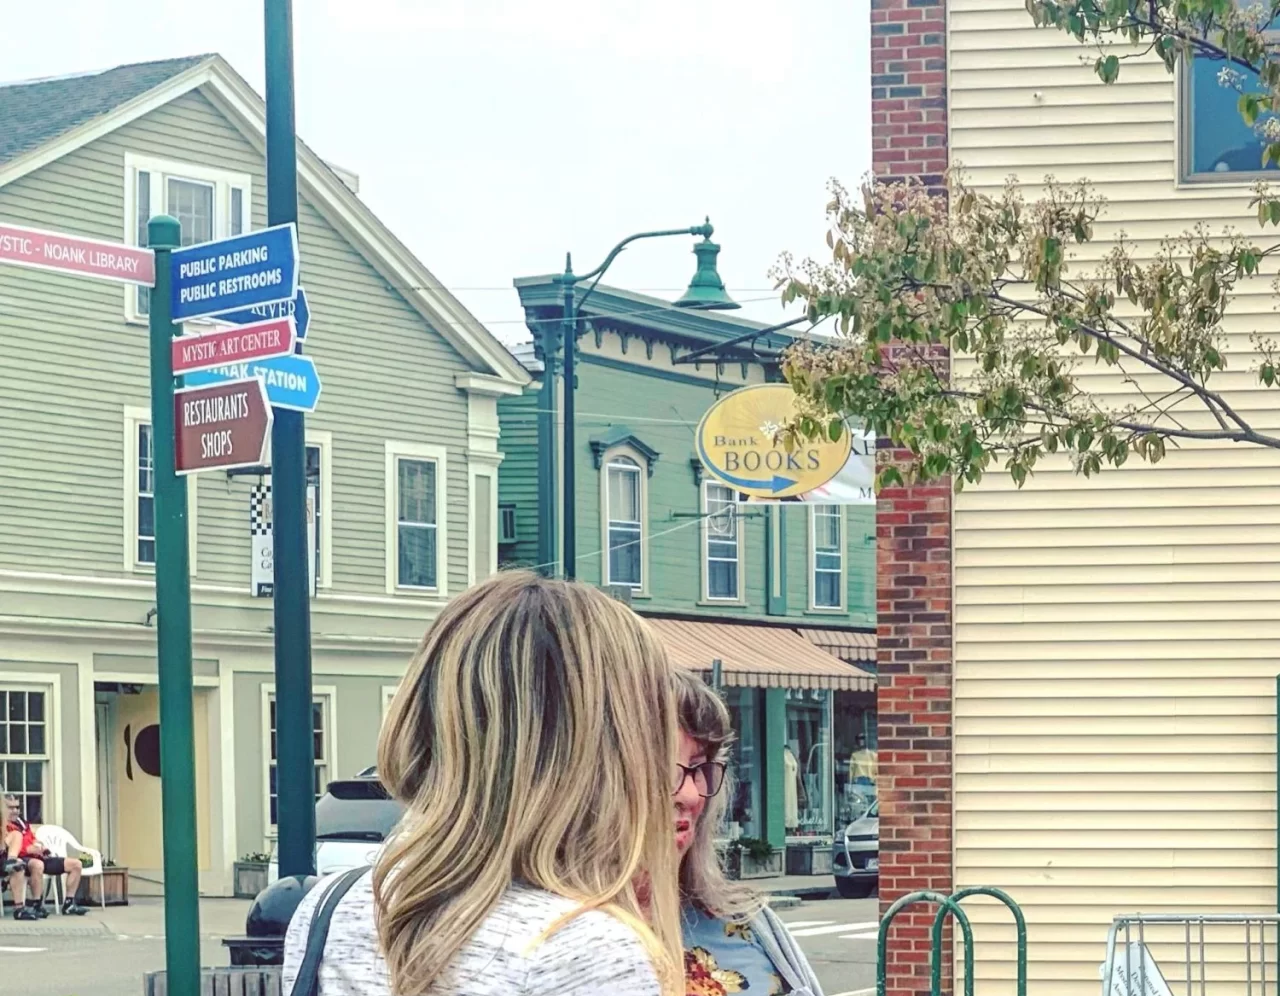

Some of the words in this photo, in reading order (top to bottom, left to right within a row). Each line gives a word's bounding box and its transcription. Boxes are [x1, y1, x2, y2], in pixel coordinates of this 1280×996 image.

[44, 242, 86, 264] NOANK
[89, 251, 139, 273] LIBRARY
[180, 257, 216, 279] PUBLIC
[219, 245, 268, 271] PARKING
[180, 282, 216, 303] PUBLIC
[219, 268, 282, 296] RESTROOMS
[182, 341, 217, 363] MYSTIC
[219, 337, 240, 356] ART
[240, 330, 281, 352] CENTER
[253, 366, 307, 392] STATION
[184, 392, 248, 427] RESTAURANTS
[201, 430, 233, 459] SHOPS
[714, 435, 758, 447] Bank
[725, 450, 820, 471] BOOKS
